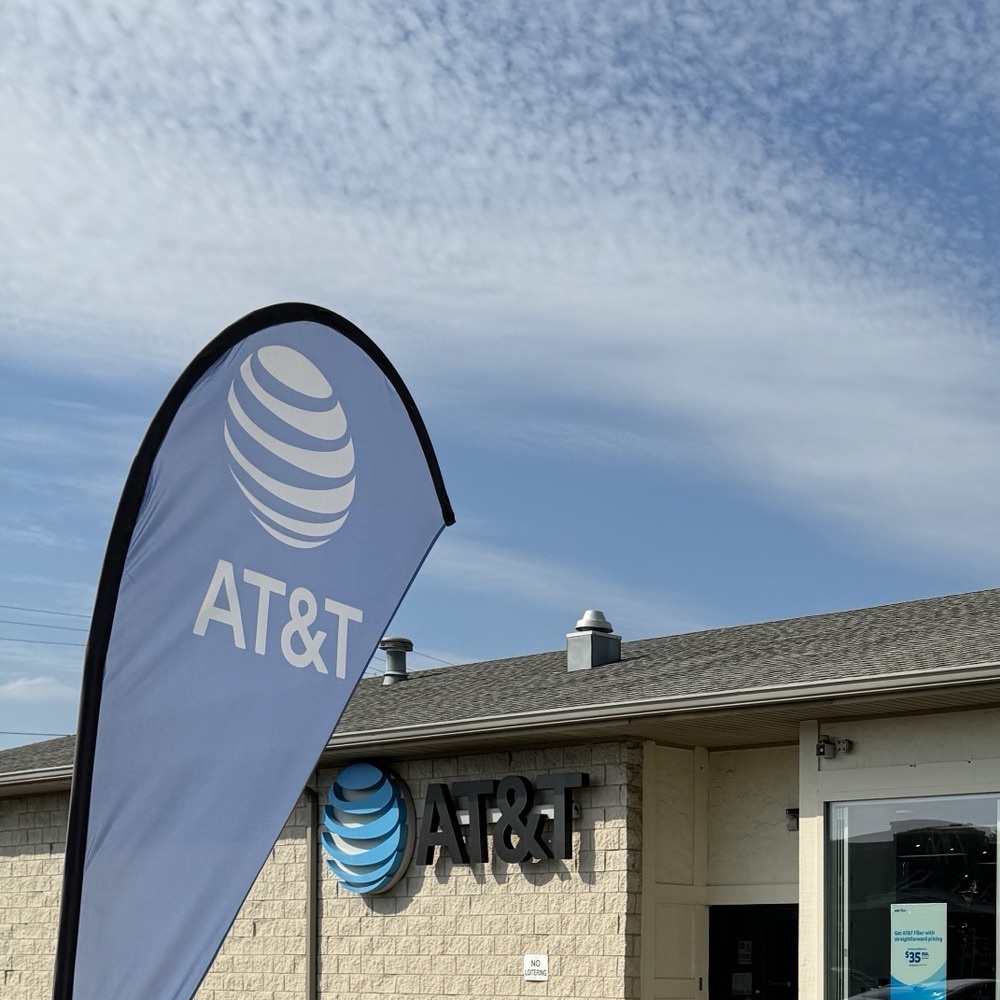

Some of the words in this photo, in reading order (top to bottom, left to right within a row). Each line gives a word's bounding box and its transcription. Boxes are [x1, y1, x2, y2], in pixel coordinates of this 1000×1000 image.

[192, 558, 363, 680] AT&T
[416, 772, 590, 866] AT&T
[530, 960, 540, 968] NO
